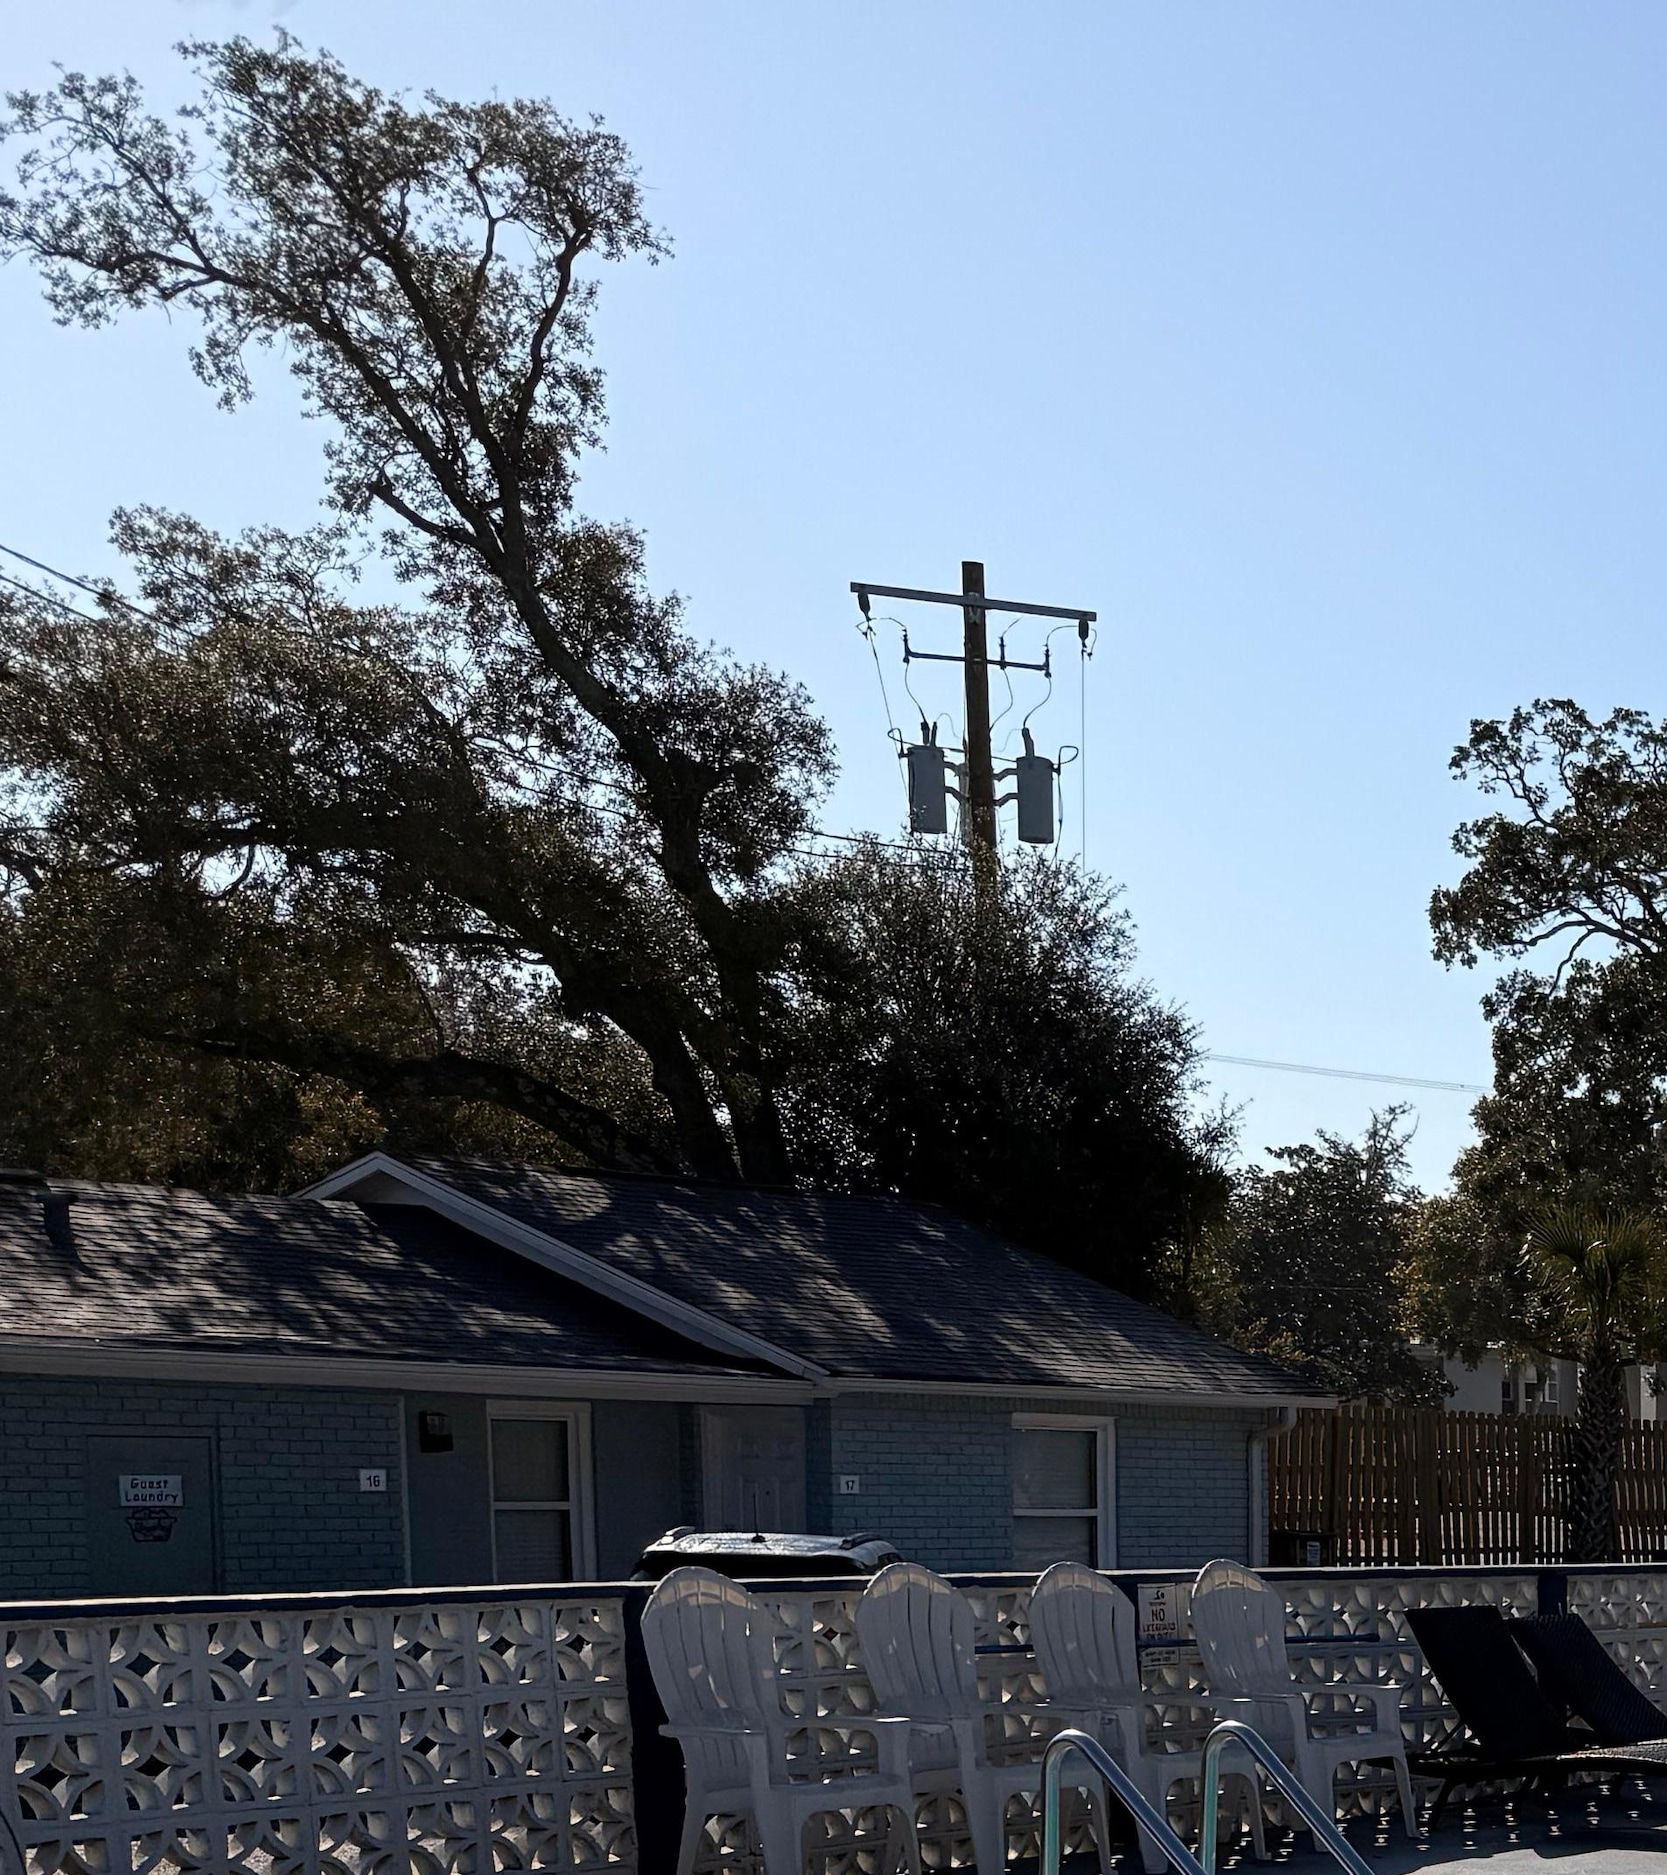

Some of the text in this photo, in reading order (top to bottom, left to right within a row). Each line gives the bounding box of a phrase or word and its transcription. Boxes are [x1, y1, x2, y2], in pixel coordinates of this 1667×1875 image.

[130, 1478, 168, 1489] Guest
[366, 1475, 380, 1487] 16
[125, 1490, 179, 1504] Laundry
